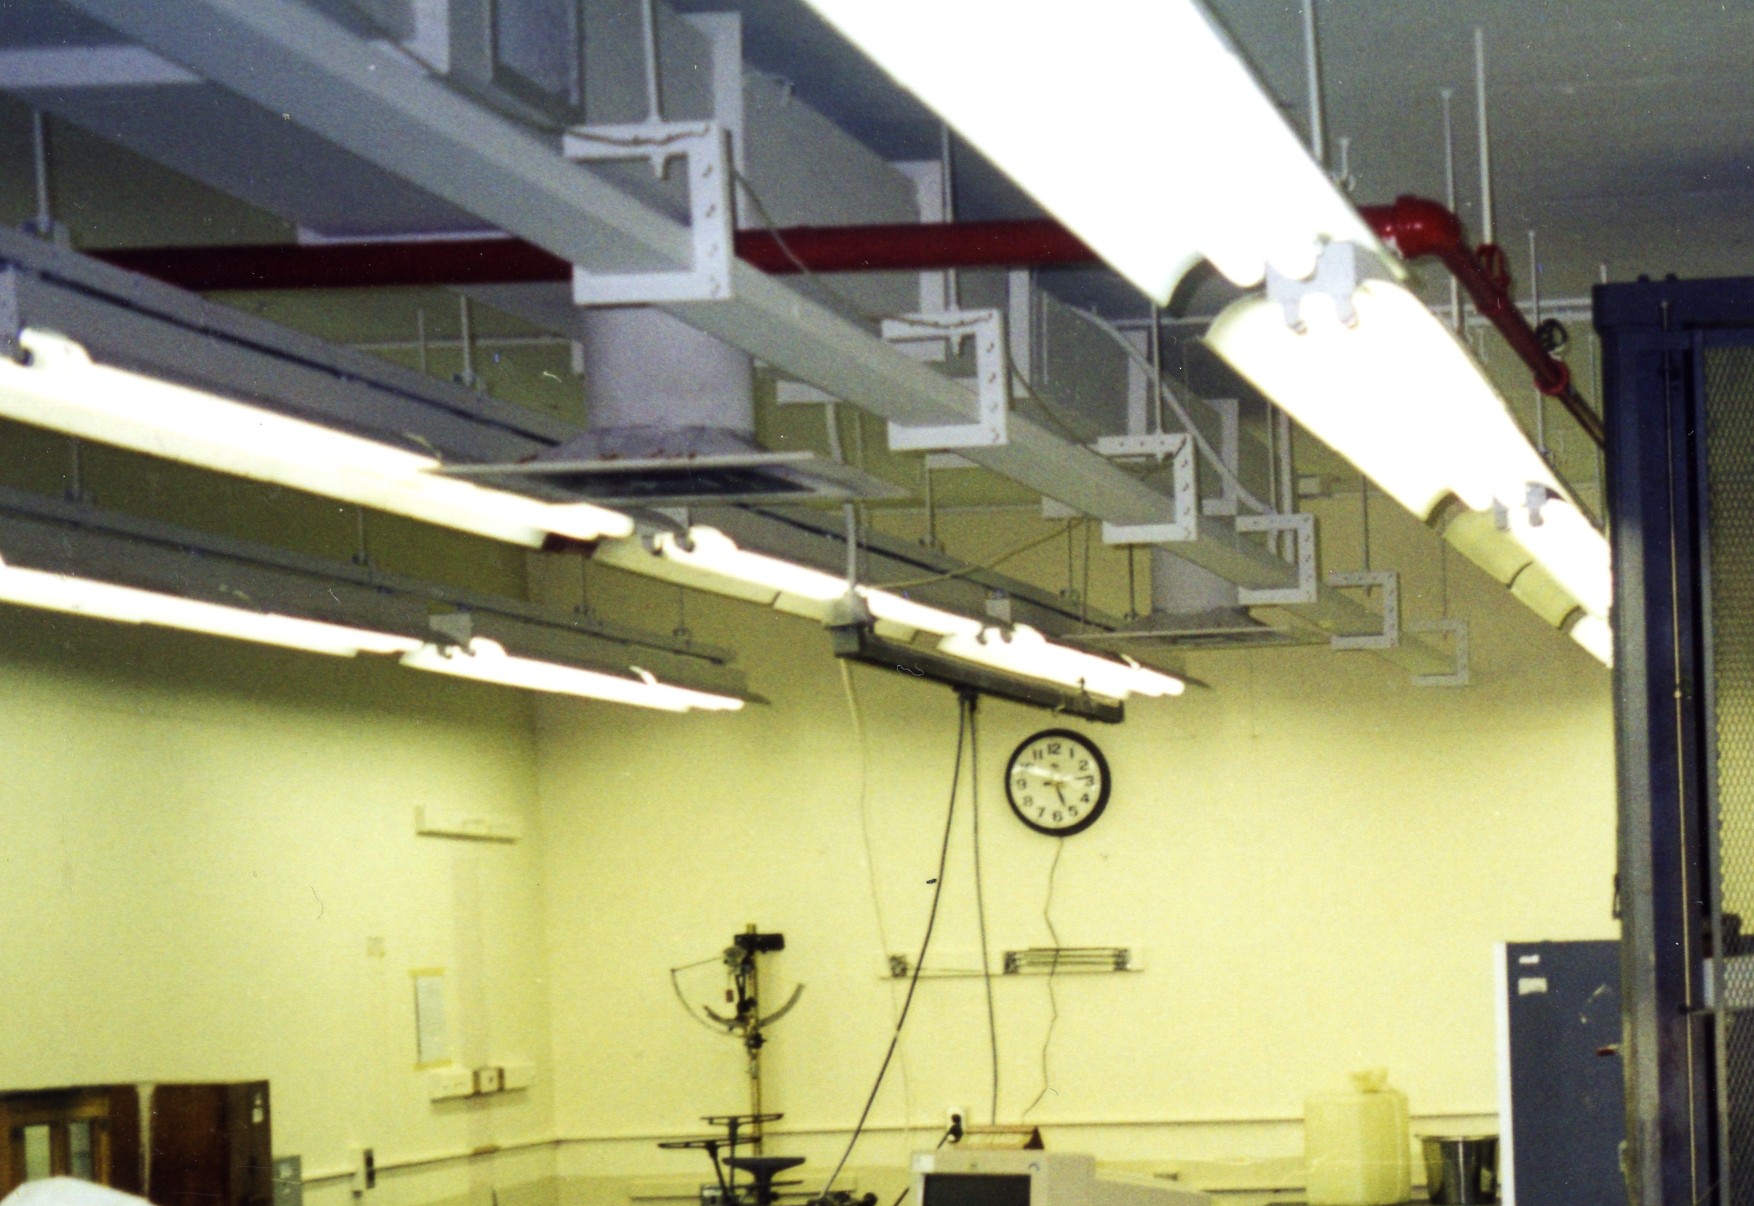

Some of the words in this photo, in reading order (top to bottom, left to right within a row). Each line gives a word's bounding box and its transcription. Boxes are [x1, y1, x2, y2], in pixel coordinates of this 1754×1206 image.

[1033, 749, 1043, 760] 11
[1047, 743, 1061, 755] 12
[1079, 760, 1089, 771] 2
[1016, 779, 1027, 790] 9
[1023, 795, 1033, 807] 8
[1081, 793, 1090, 804] 4
[1037, 807, 1045, 817] 7
[1053, 811, 1063, 822] 6
[1068, 806, 1079, 817] 5
